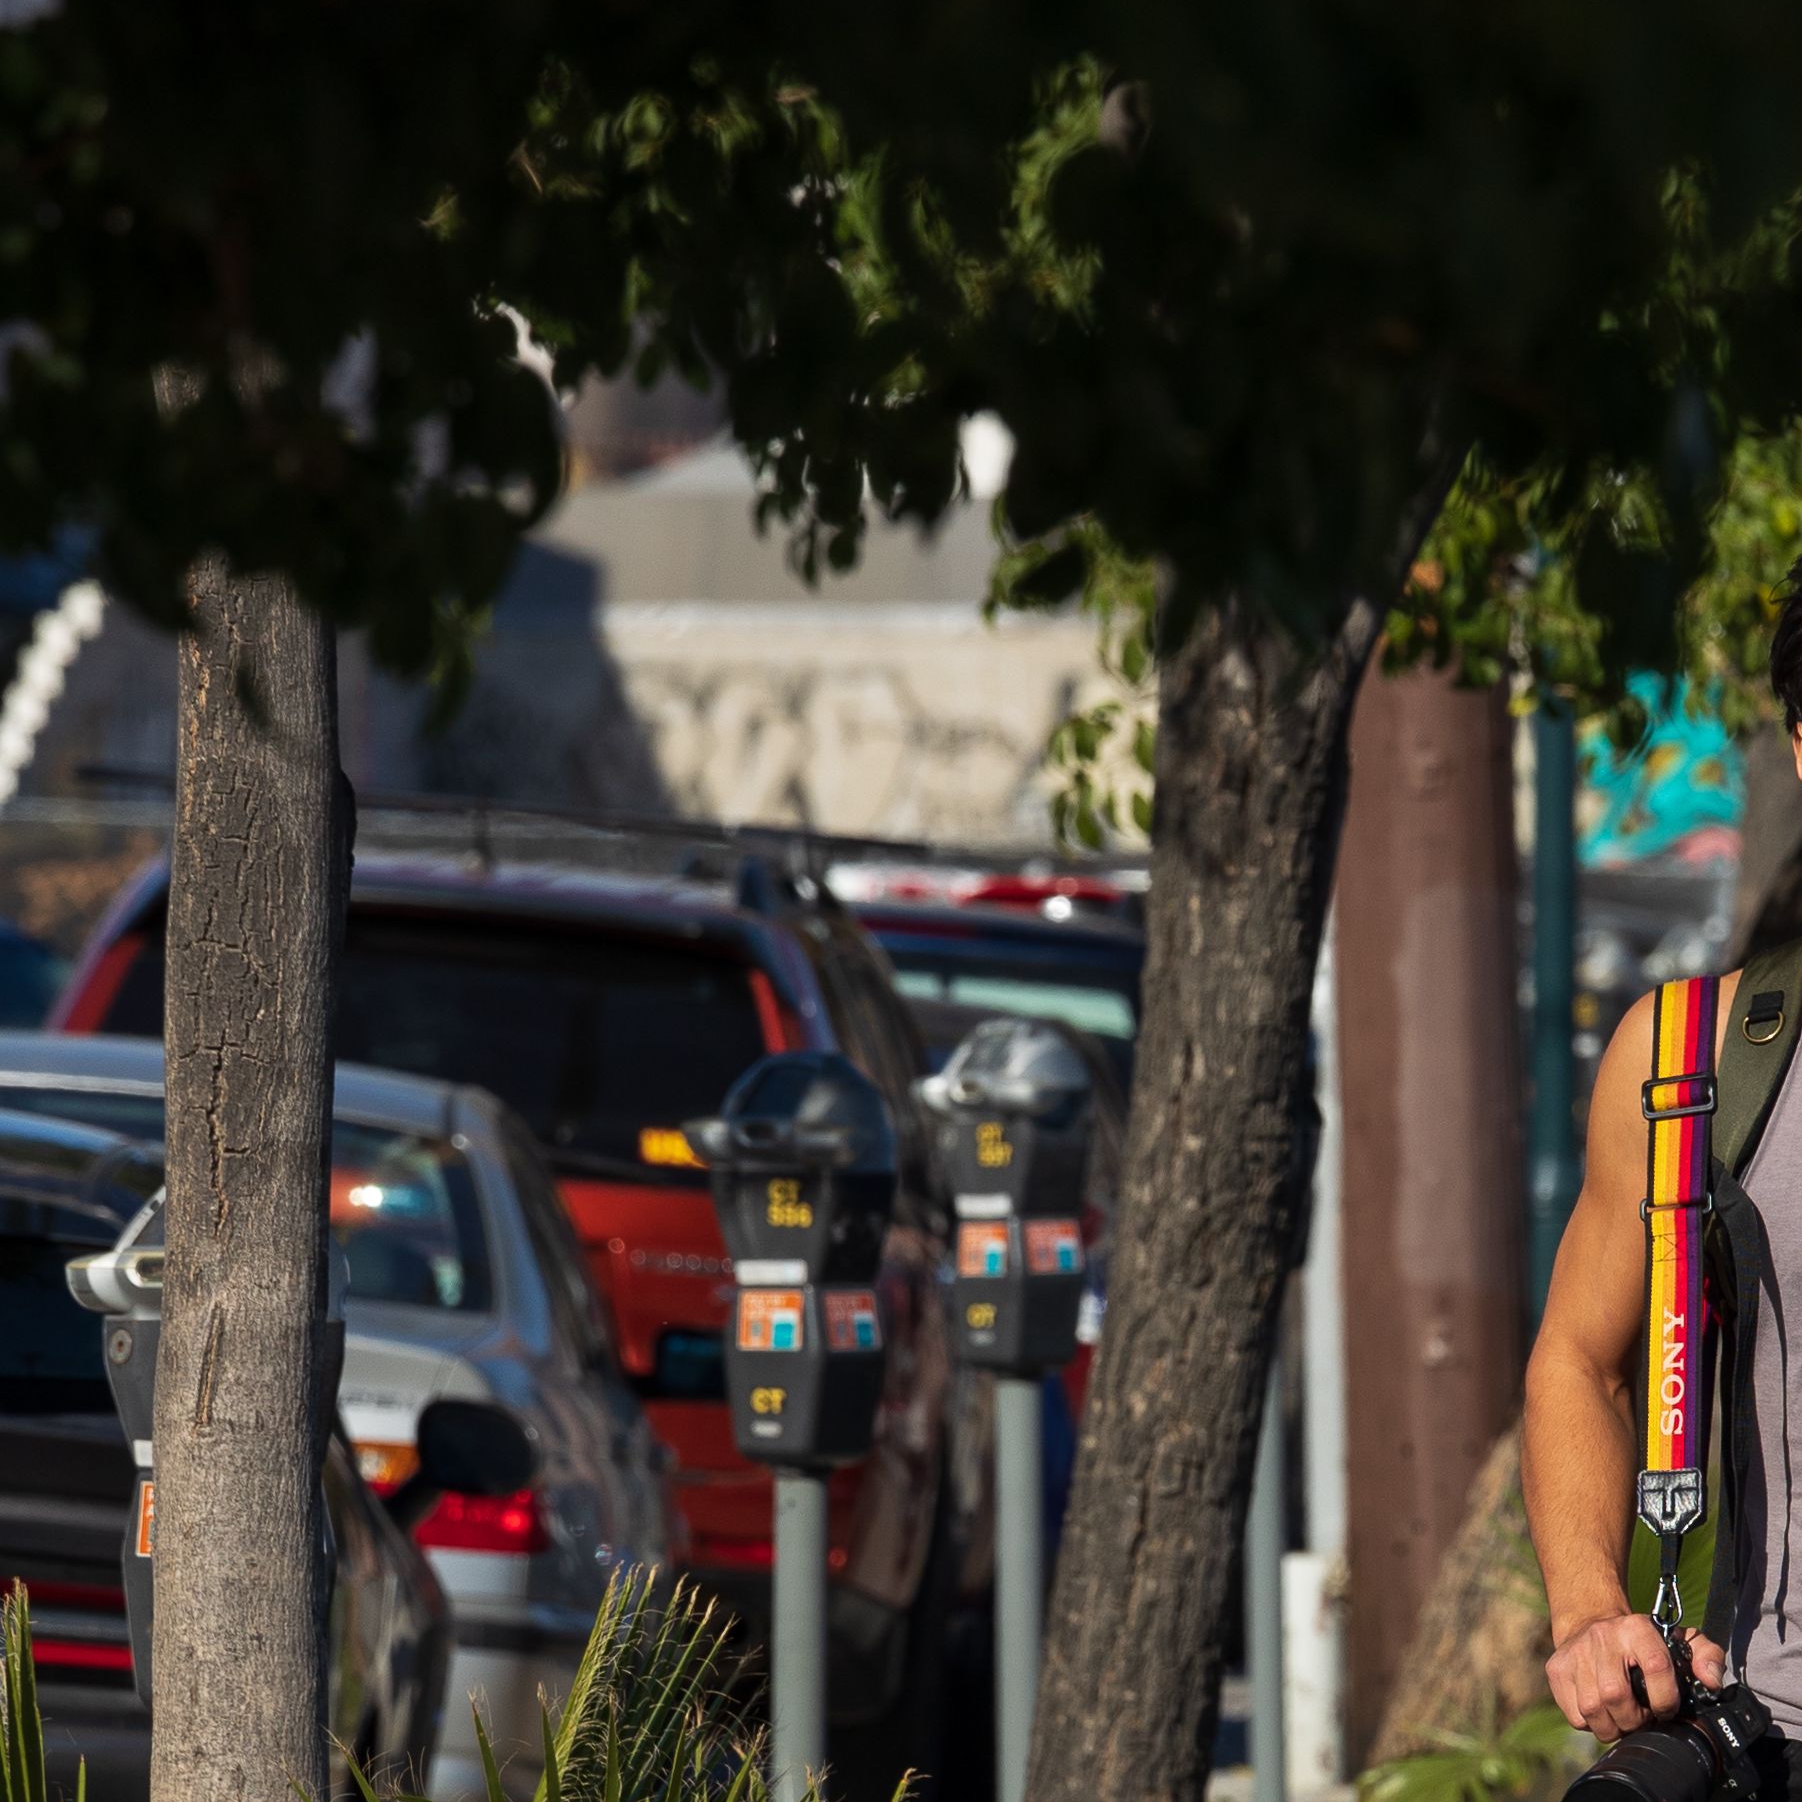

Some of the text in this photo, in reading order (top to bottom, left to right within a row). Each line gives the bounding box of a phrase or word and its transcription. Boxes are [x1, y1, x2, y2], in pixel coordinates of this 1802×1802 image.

[768, 1179, 798, 1203] CT
[1660, 1306, 1685, 1436] SONY
[751, 1387, 786, 1414] CT
[1718, 1717, 1740, 1748] SONY
